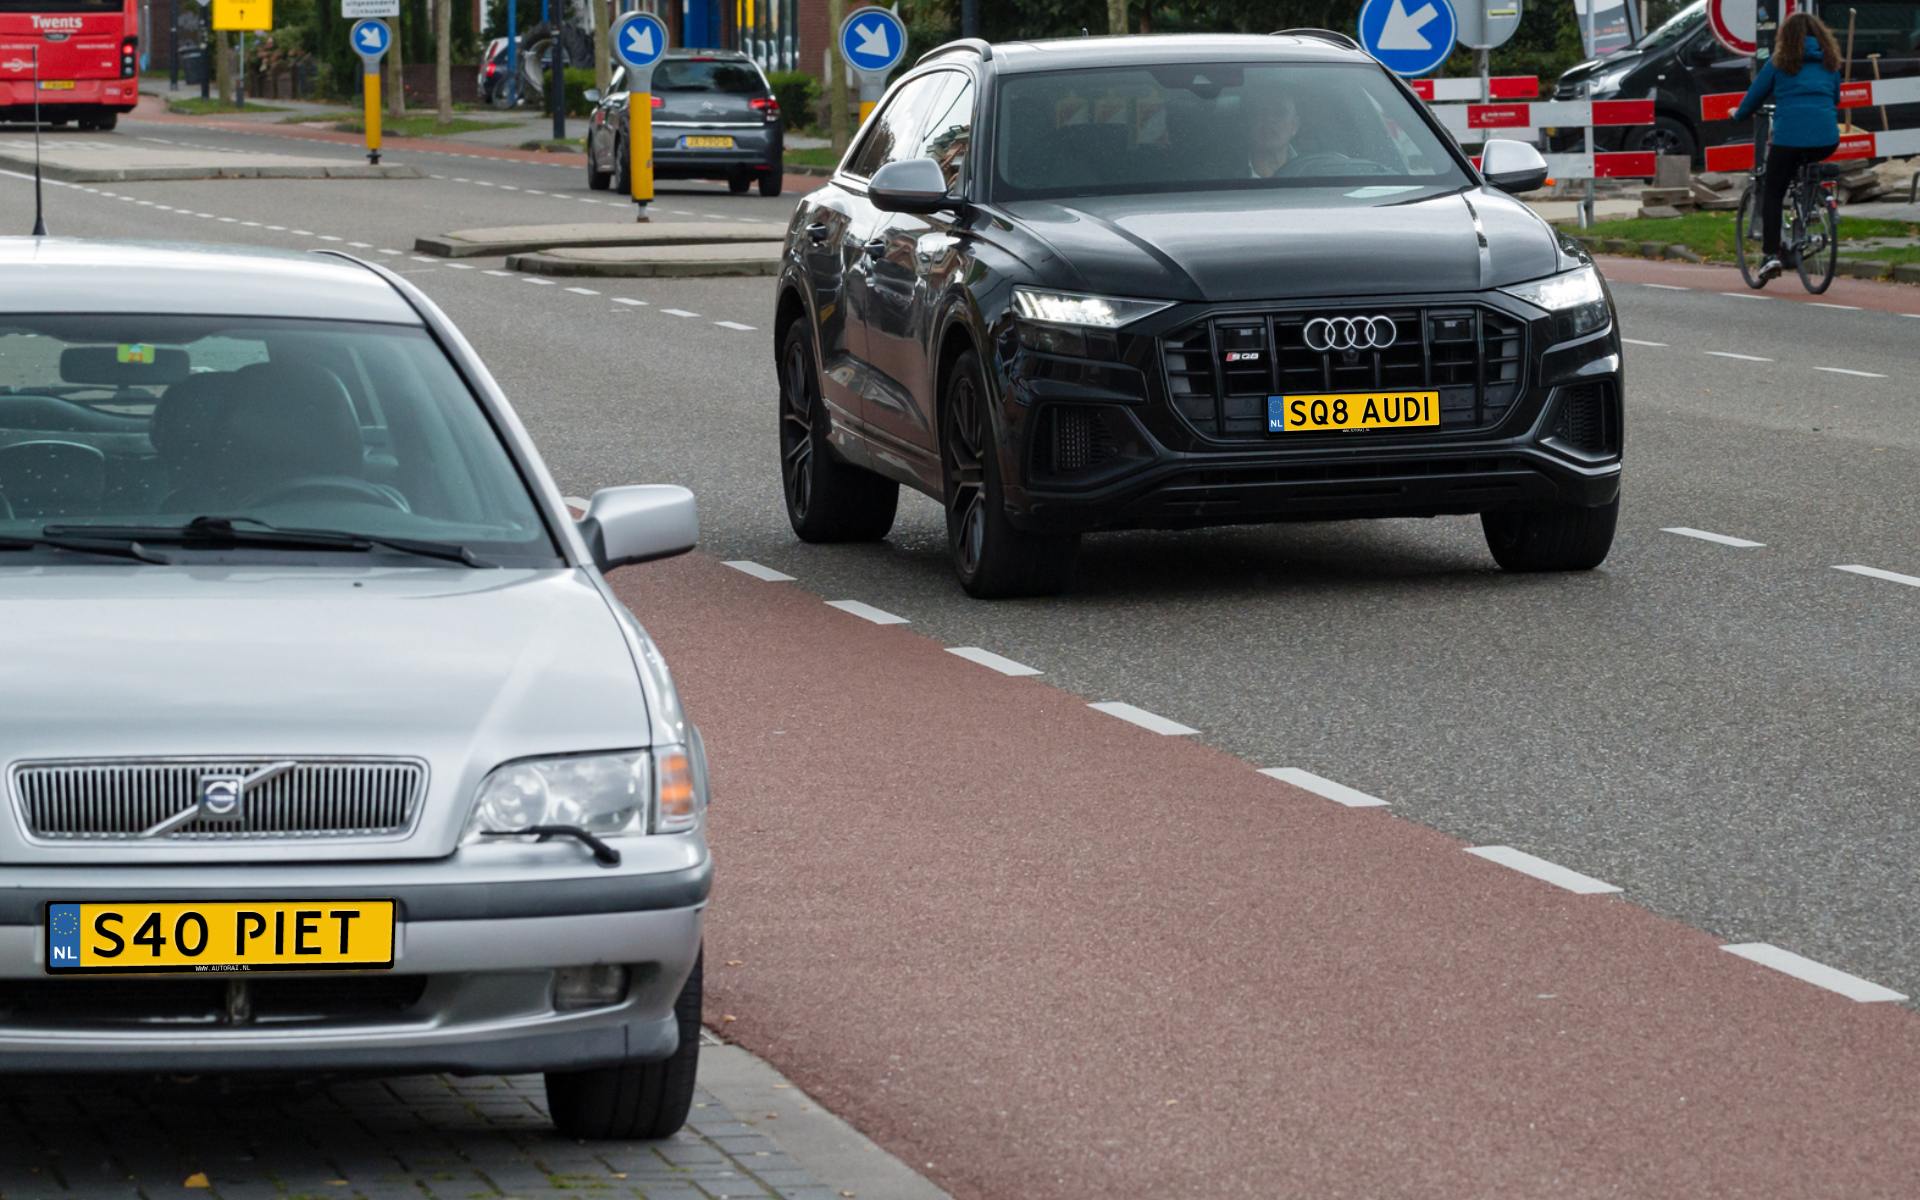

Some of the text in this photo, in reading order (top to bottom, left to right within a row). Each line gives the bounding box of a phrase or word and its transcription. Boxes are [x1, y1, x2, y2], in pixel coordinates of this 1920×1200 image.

[31, 15, 83, 28] Twents
[1290, 397, 1430, 426] SQ8 AUDI
[1270, 419, 1283, 428] NL
[93, 911, 360, 958] S40 PIET
[53, 946, 78, 960] NL
